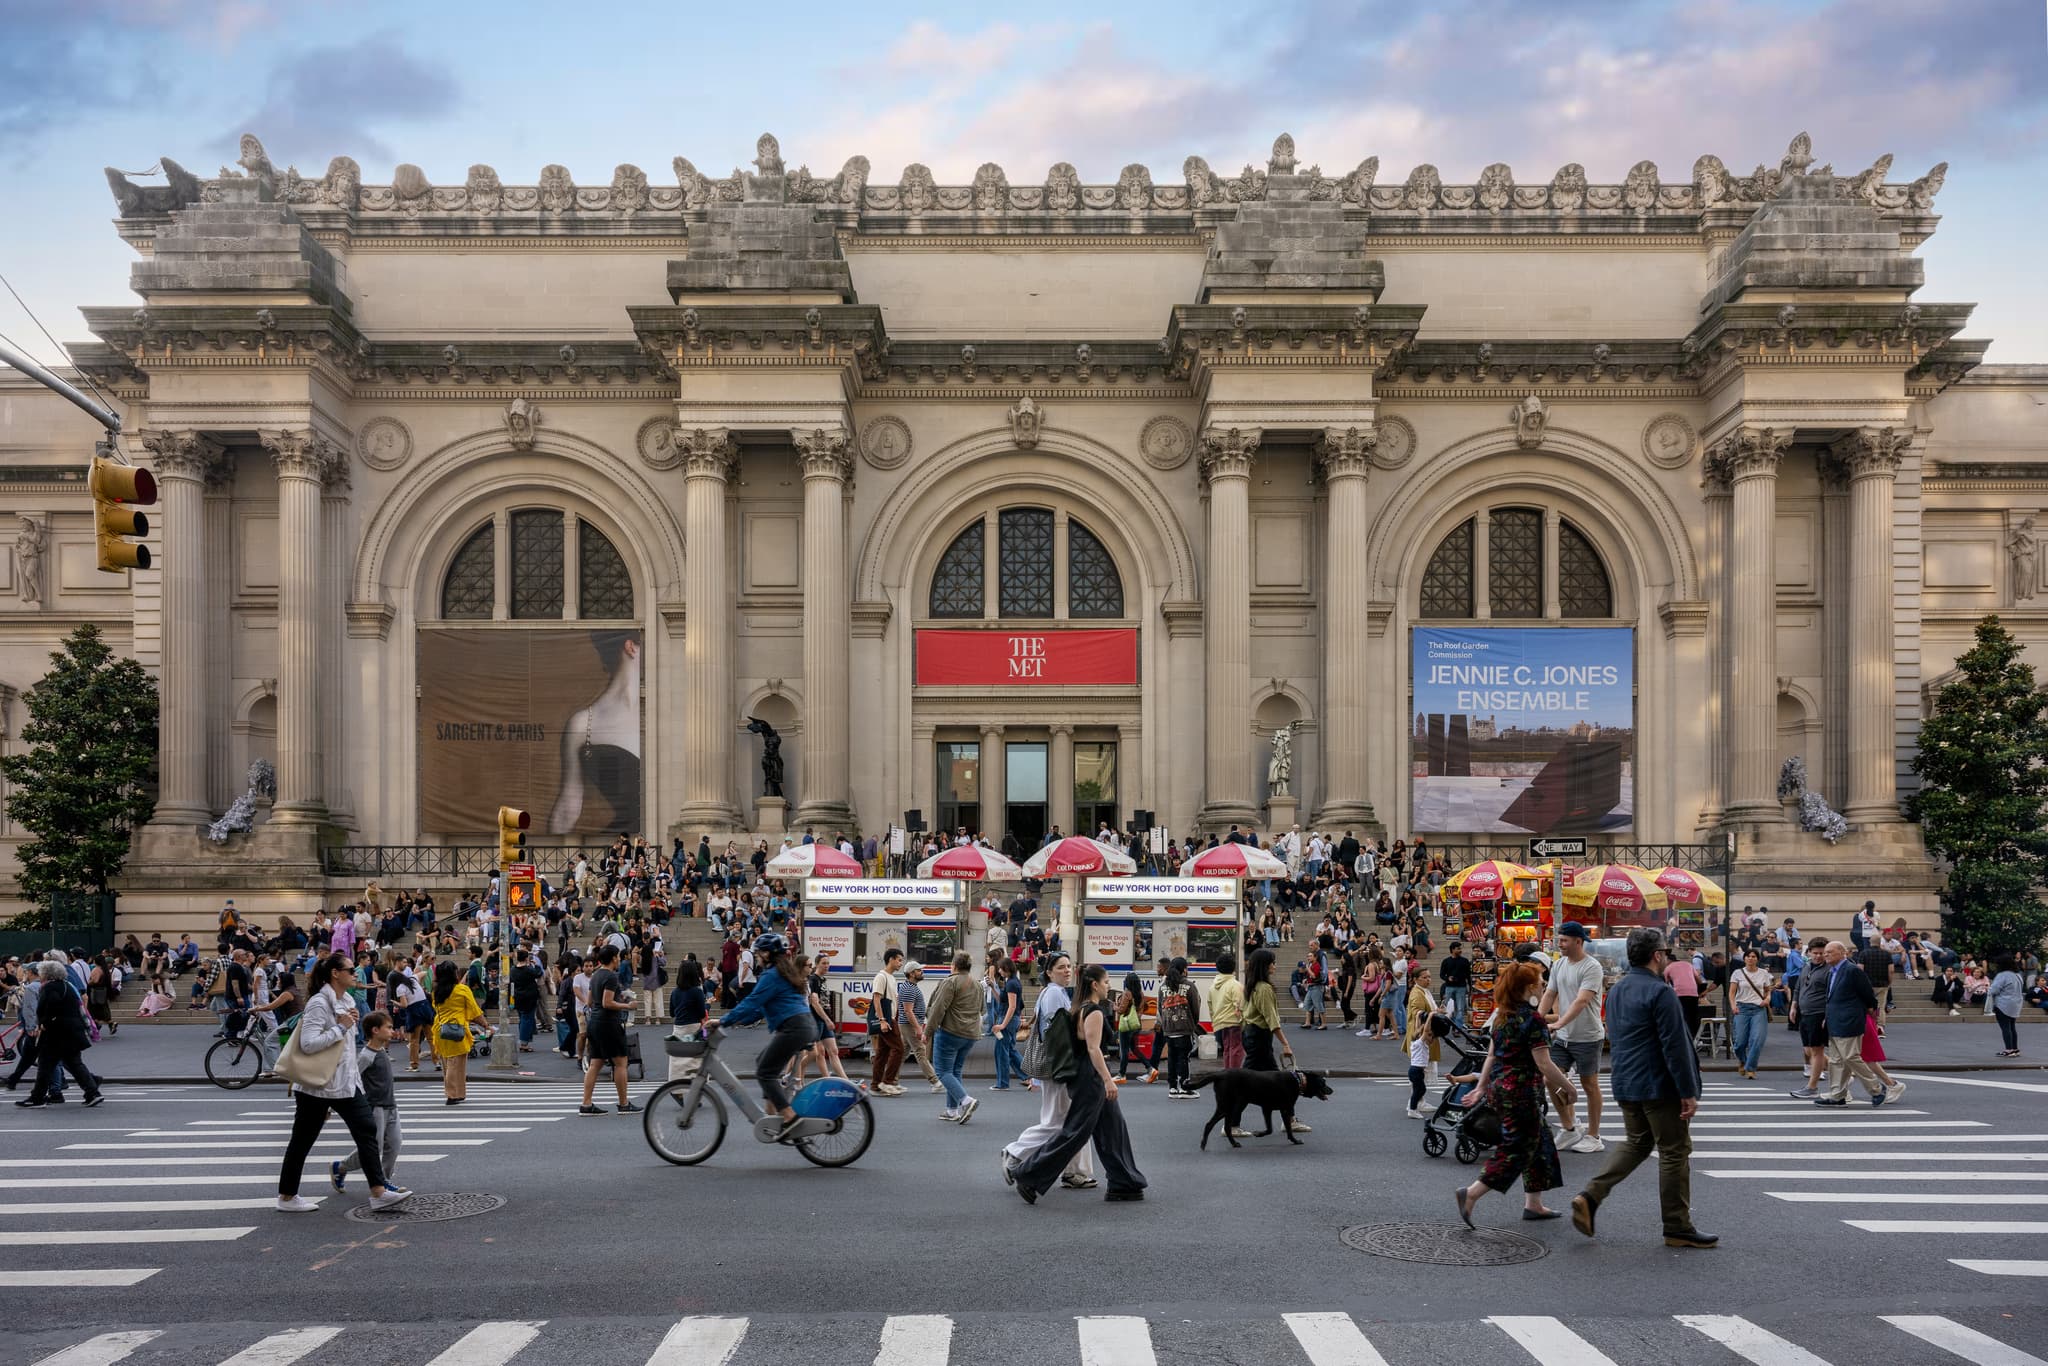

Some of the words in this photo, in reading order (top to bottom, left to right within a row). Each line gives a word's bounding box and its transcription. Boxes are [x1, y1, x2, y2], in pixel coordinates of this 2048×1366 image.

[1008, 637, 1046, 657] THE
[1428, 641, 1443, 650] The
[1444, 641, 1461, 650] Roof
[1462, 642, 1489, 650] Garden
[1428, 651, 1473, 659] Commission
[1008, 658, 1046, 677] MET
[1428, 665, 1508, 685] JENNIE
[1513, 665, 1537, 686] C.
[1541, 665, 1618, 686] JONES
[1457, 691, 1590, 711] ENSEMBLE
[436, 722, 493, 741] SARGENT
[494, 723, 506, 740] &
[508, 723, 545, 741] PARIS
[1538, 844, 1555, 852] ONE
[1562, 843, 1579, 851] WAY
[1073, 863, 1095, 871] DRINKS
[822, 885, 843, 893] NEW
[845, 885, 870, 894] YORK
[872, 885, 890, 894] HOT
[893, 886, 914, 894] DOG
[916, 886, 938, 894] KING
[1103, 884, 1124, 892] NEW
[1126, 884, 1150, 893] YORK
[1153, 885, 1172, 893] HOT
[1174, 885, 1195, 893] DOG
[1197, 885, 1219, 893] KING
[834, 936, 849, 944] Dogs
[843, 981, 873, 993] NEW
